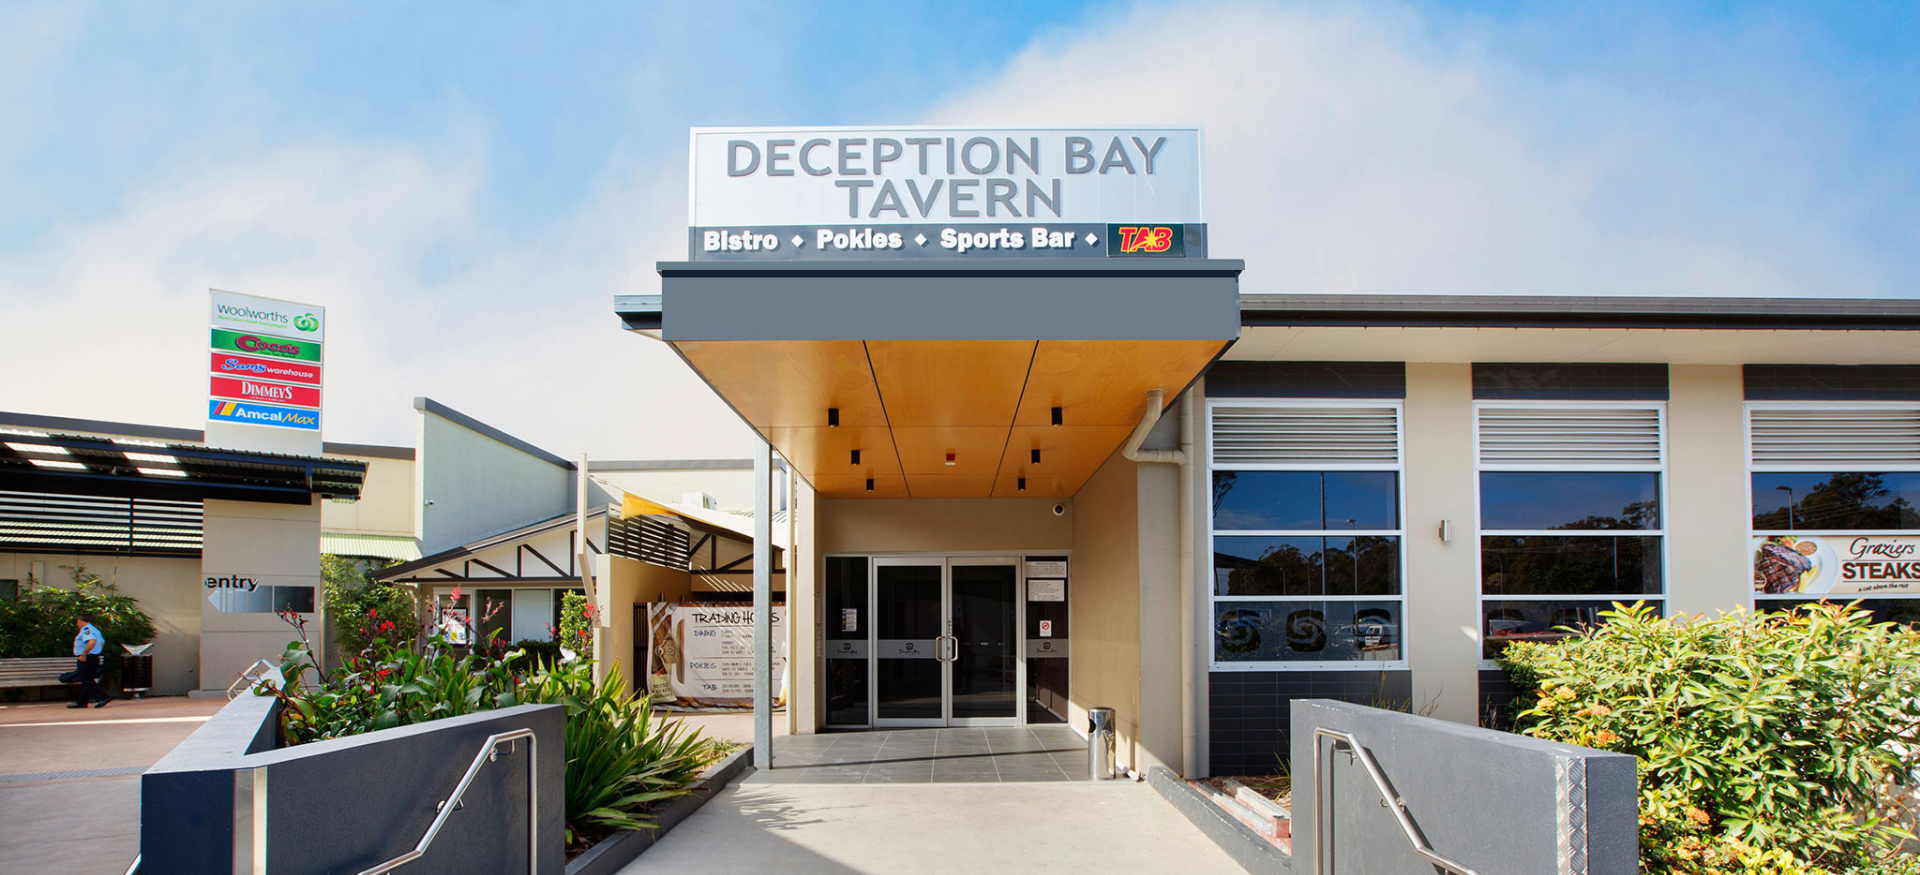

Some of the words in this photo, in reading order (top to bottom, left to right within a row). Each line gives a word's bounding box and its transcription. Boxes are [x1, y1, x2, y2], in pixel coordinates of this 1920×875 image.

[727, 136, 1039, 177] DECEPTION
[1065, 136, 1167, 174] BAY
[834, 178, 1062, 218] TAVERN
[704, 230, 779, 251] Bistro
[816, 228, 903, 249] Pokies
[940, 227, 1024, 253] Sports
[1031, 227, 1075, 248] Bar
[1119, 226, 1173, 253] TAB
[217, 304, 289, 324] Woolworths
[235, 335, 300, 355] Coco's
[267, 367, 314, 379] warehouse
[1849, 537, 1916, 560] Graziers
[205, 574, 259, 592] entry
[692, 613, 740, 624] TRADING
[743, 611, 780, 624] HOS
